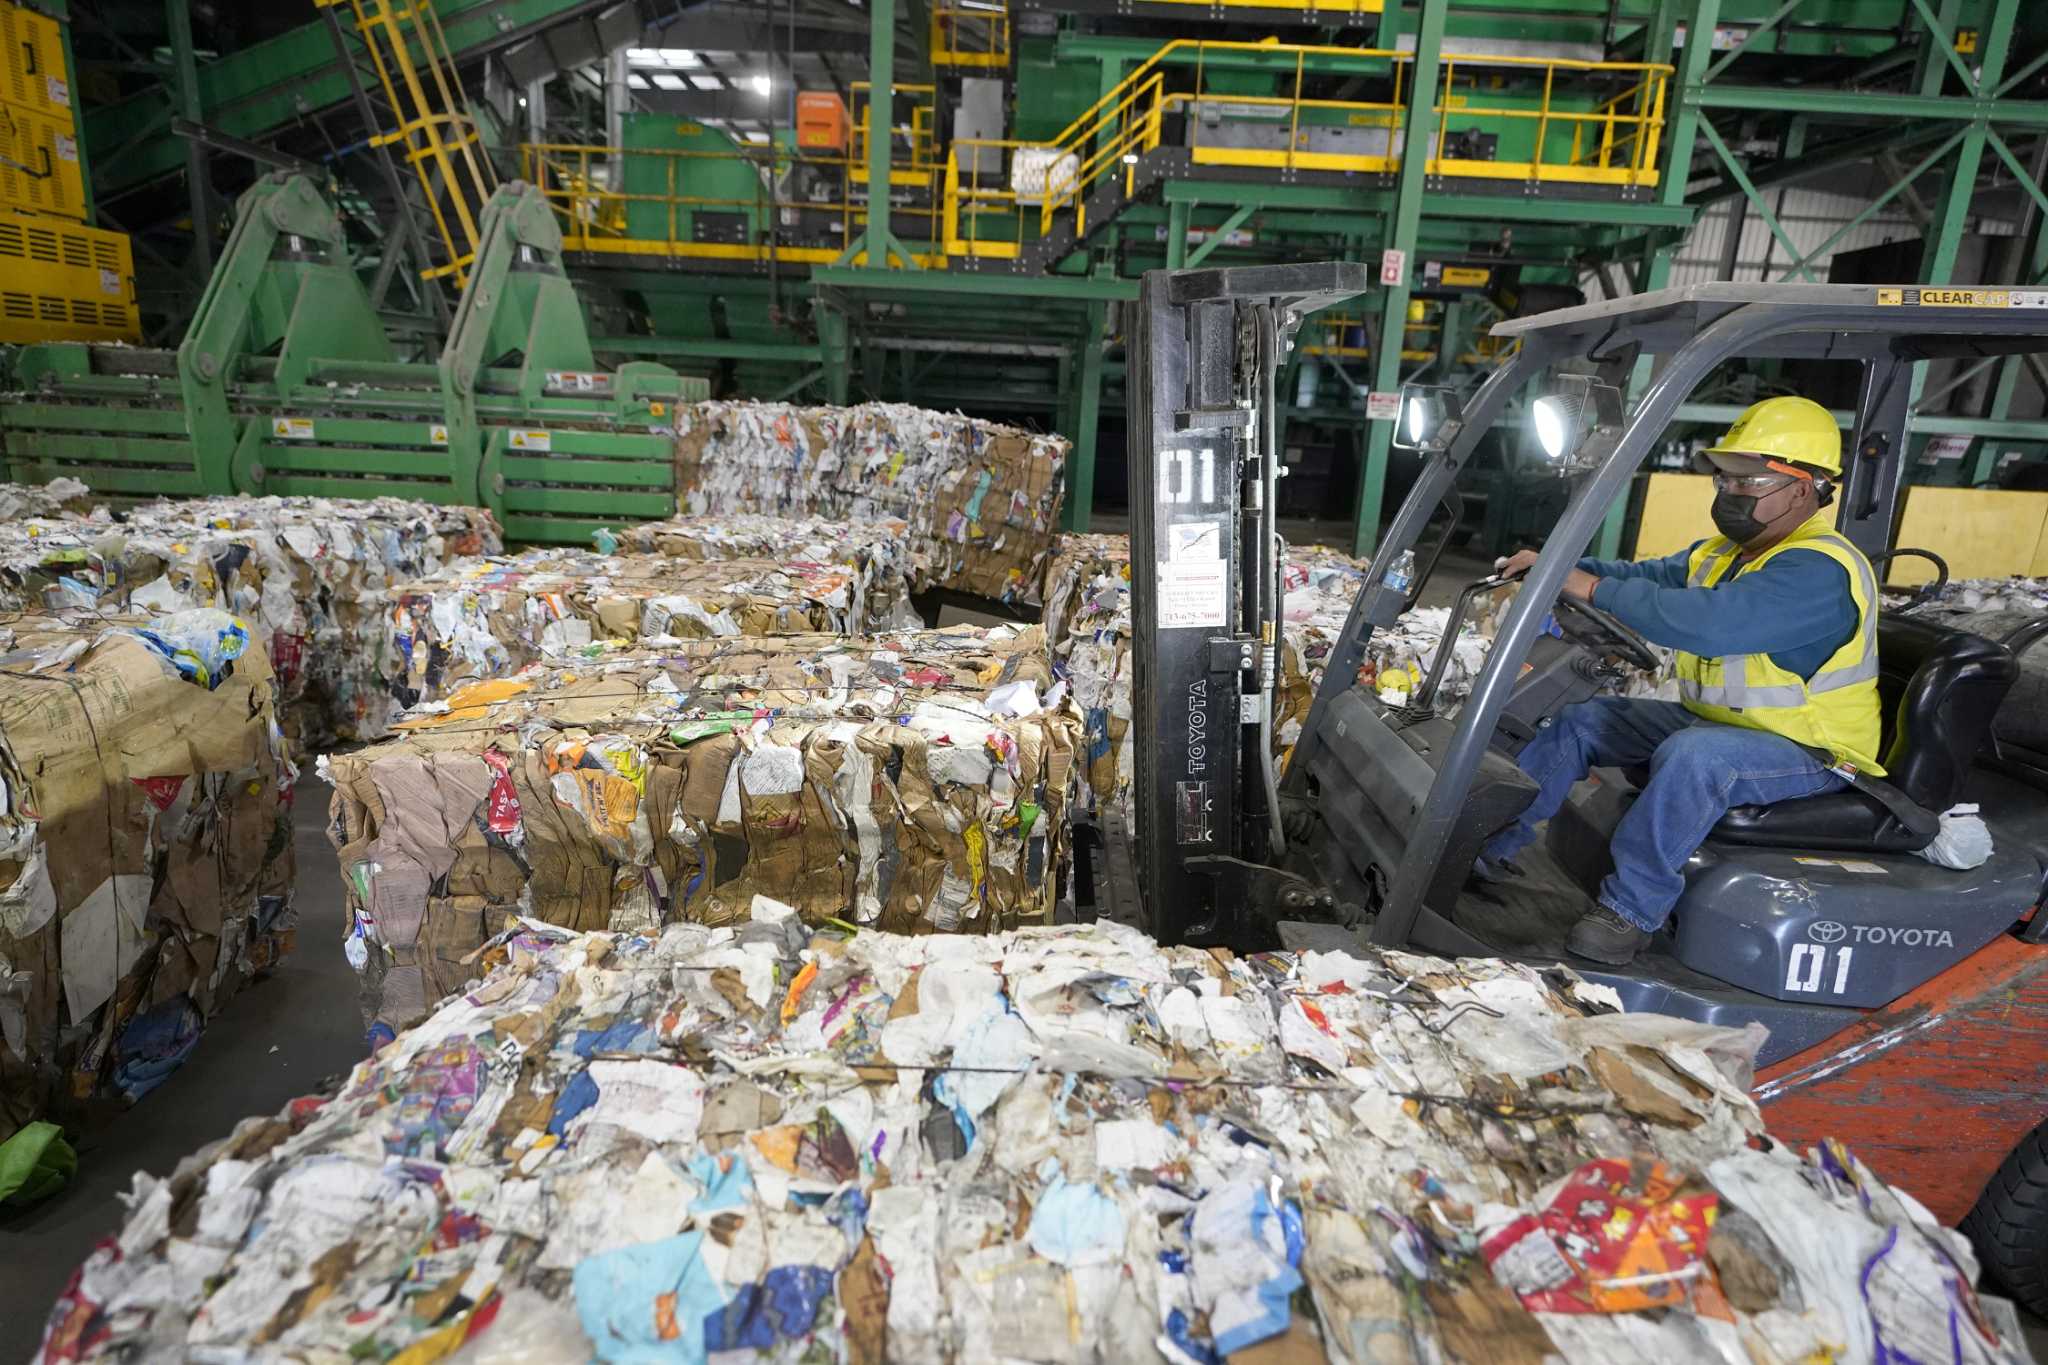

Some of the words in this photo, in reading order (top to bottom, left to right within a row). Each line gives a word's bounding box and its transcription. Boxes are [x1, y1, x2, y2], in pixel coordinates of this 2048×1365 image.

[1160, 448, 1214, 503] 01
[1188, 679, 1207, 775] TOYOTA
[1852, 925, 1954, 948] TOYOTA
[1785, 943, 1853, 994] 01
